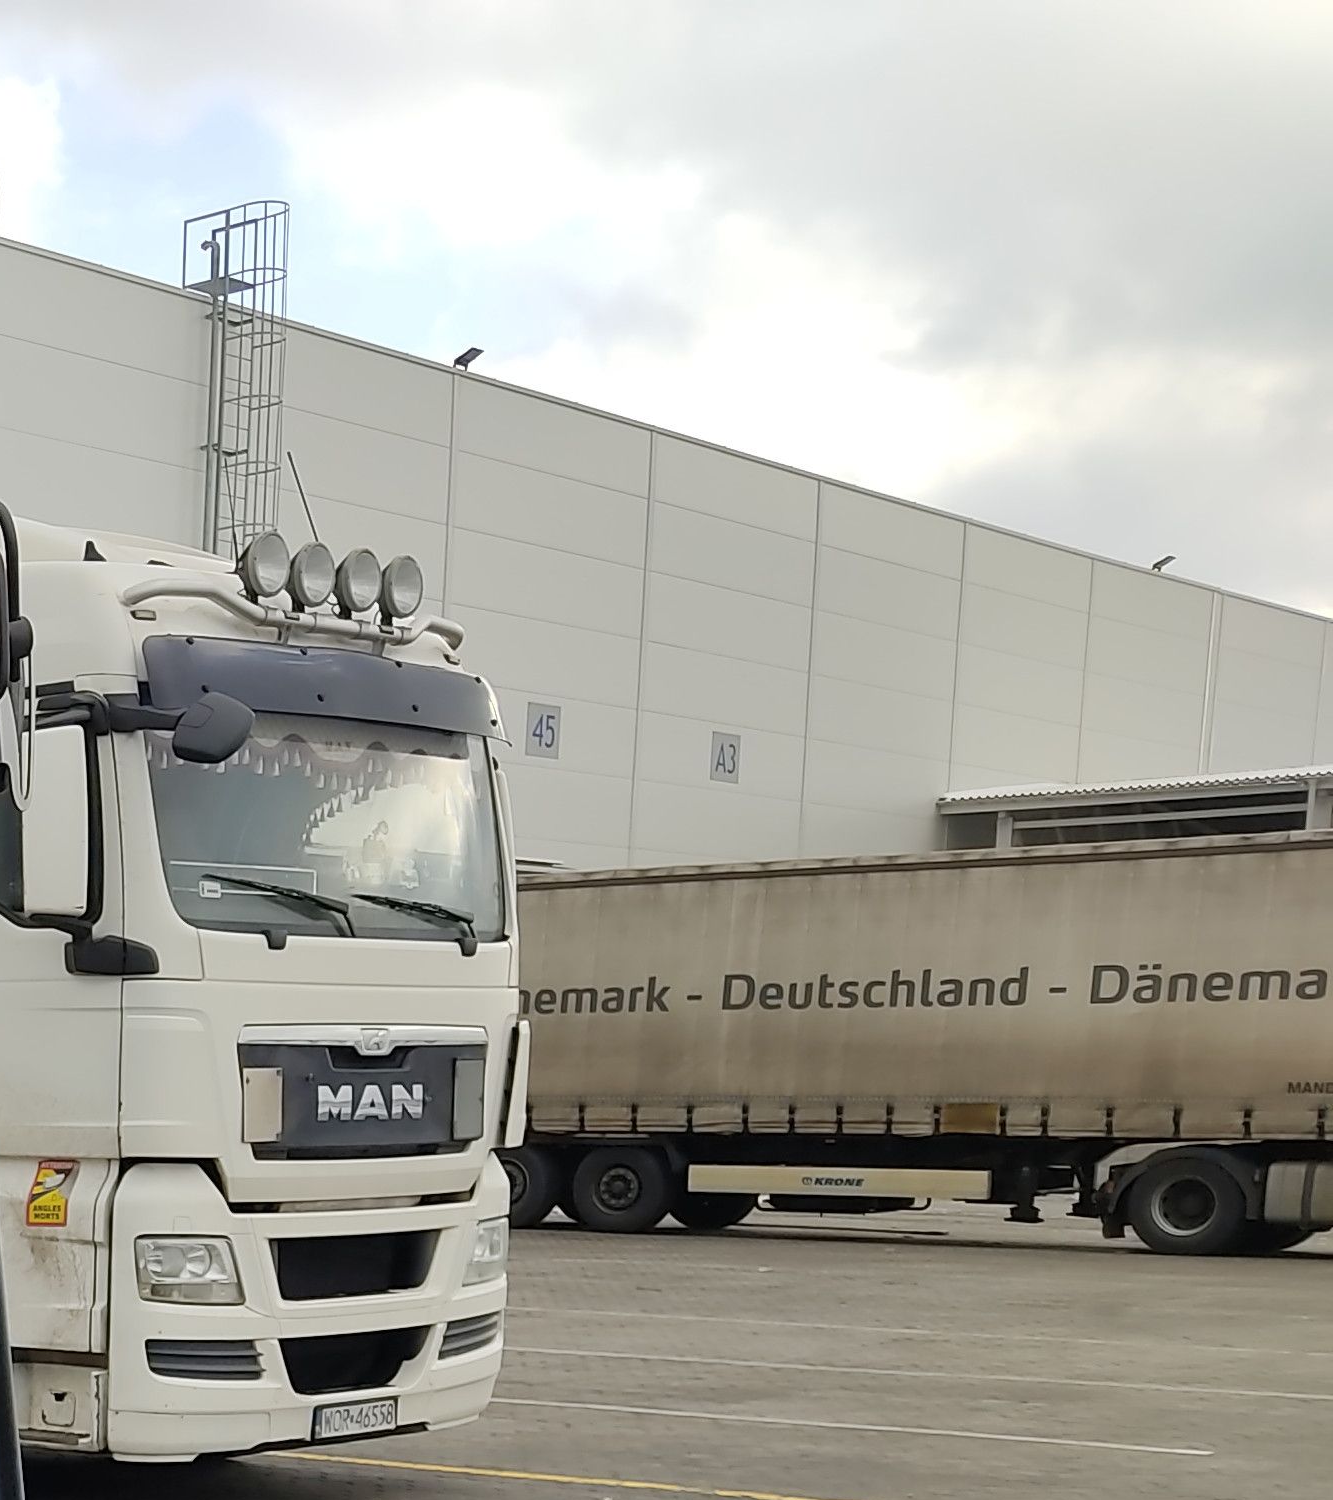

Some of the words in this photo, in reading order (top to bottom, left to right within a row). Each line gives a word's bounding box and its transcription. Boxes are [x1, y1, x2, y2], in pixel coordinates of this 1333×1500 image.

[532, 713, 556, 749] 45
[715, 743, 737, 774] A3
[721, 966, 1030, 1011] Deutschland
[1089, 963, 1329, 1005] Dänema
[316, 1083, 424, 1122] MAN
[814, 1177, 865, 1187] KRONE
[33, 1204, 62, 1212] ANGLES
[33, 1212, 60, 1220] MORTS
